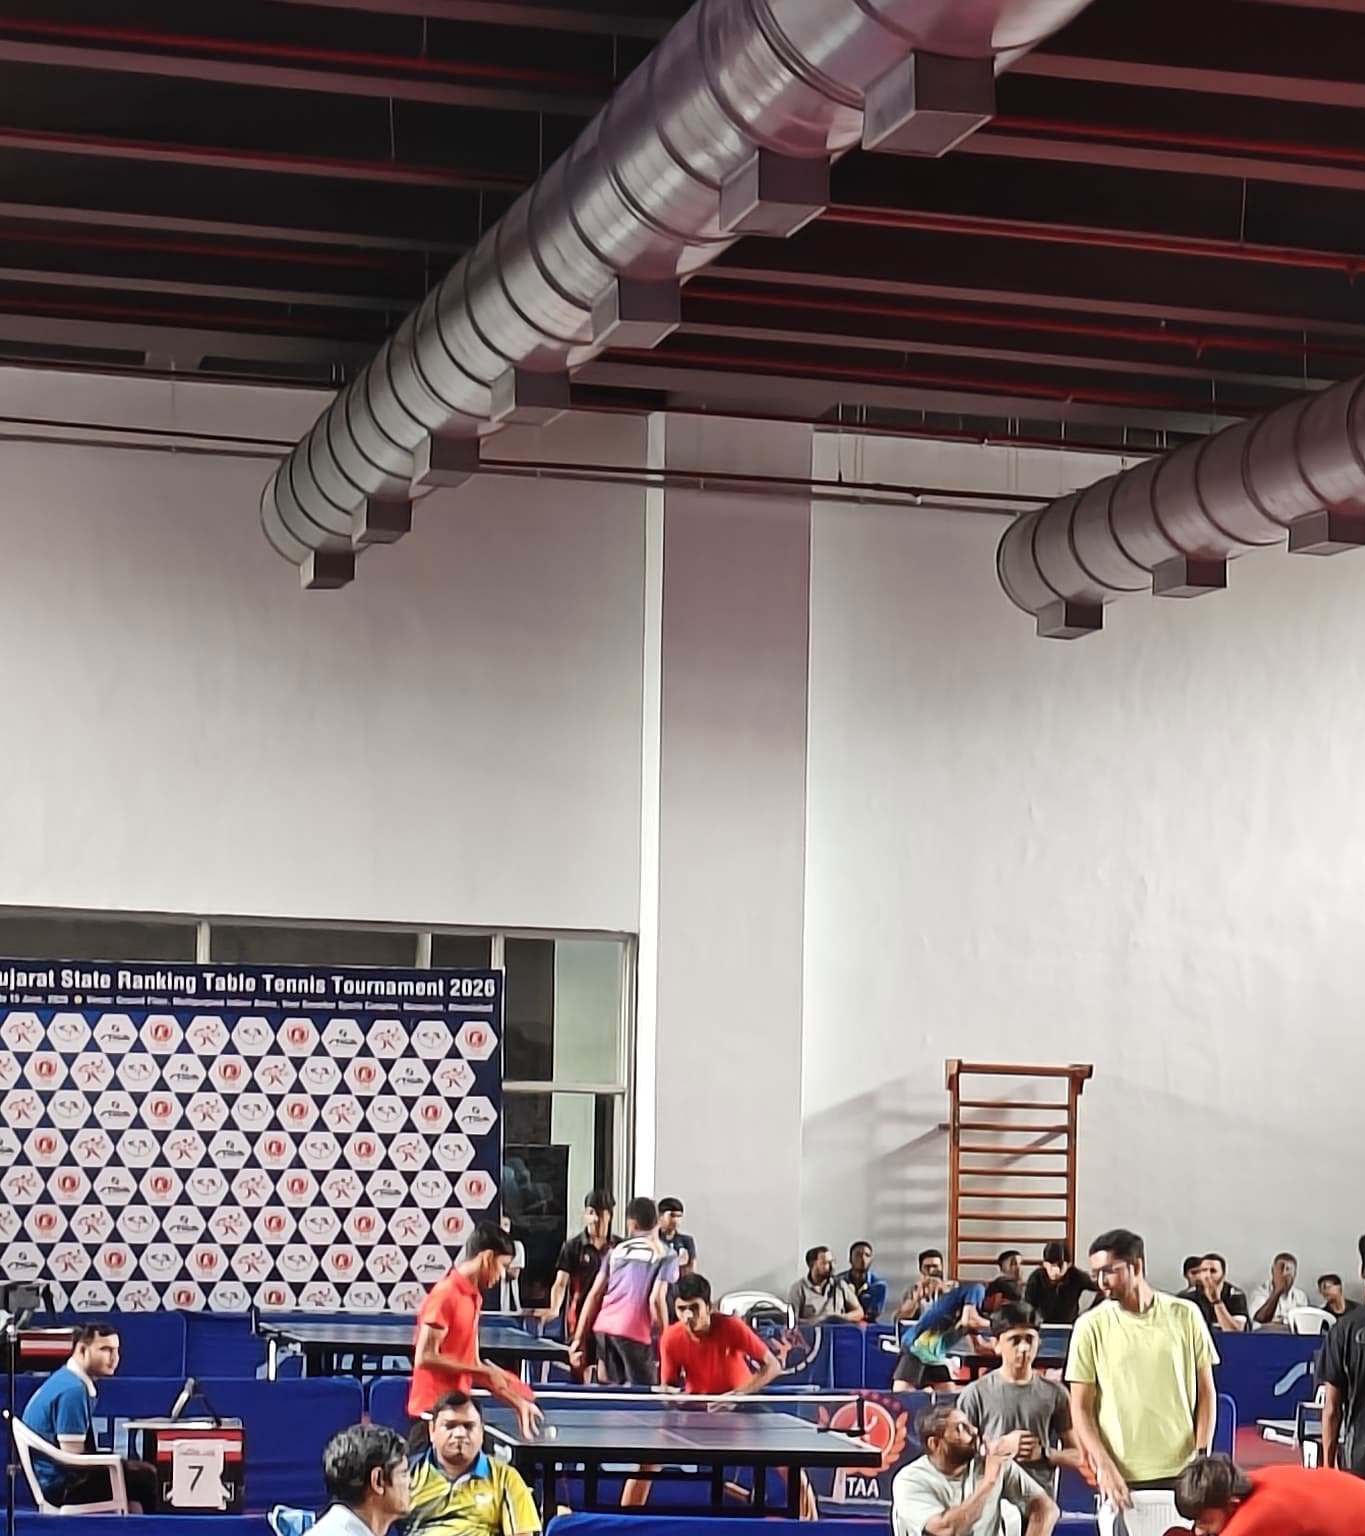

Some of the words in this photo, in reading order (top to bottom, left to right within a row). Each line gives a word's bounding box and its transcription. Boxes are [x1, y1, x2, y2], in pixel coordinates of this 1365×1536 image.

[60, 969, 111, 989] State
[118, 970, 197, 994] Ranking
[203, 972, 257, 992] Table
[262, 974, 326, 994] Tennis
[332, 976, 444, 997] Tournament
[188, 1465, 204, 1491] 7
